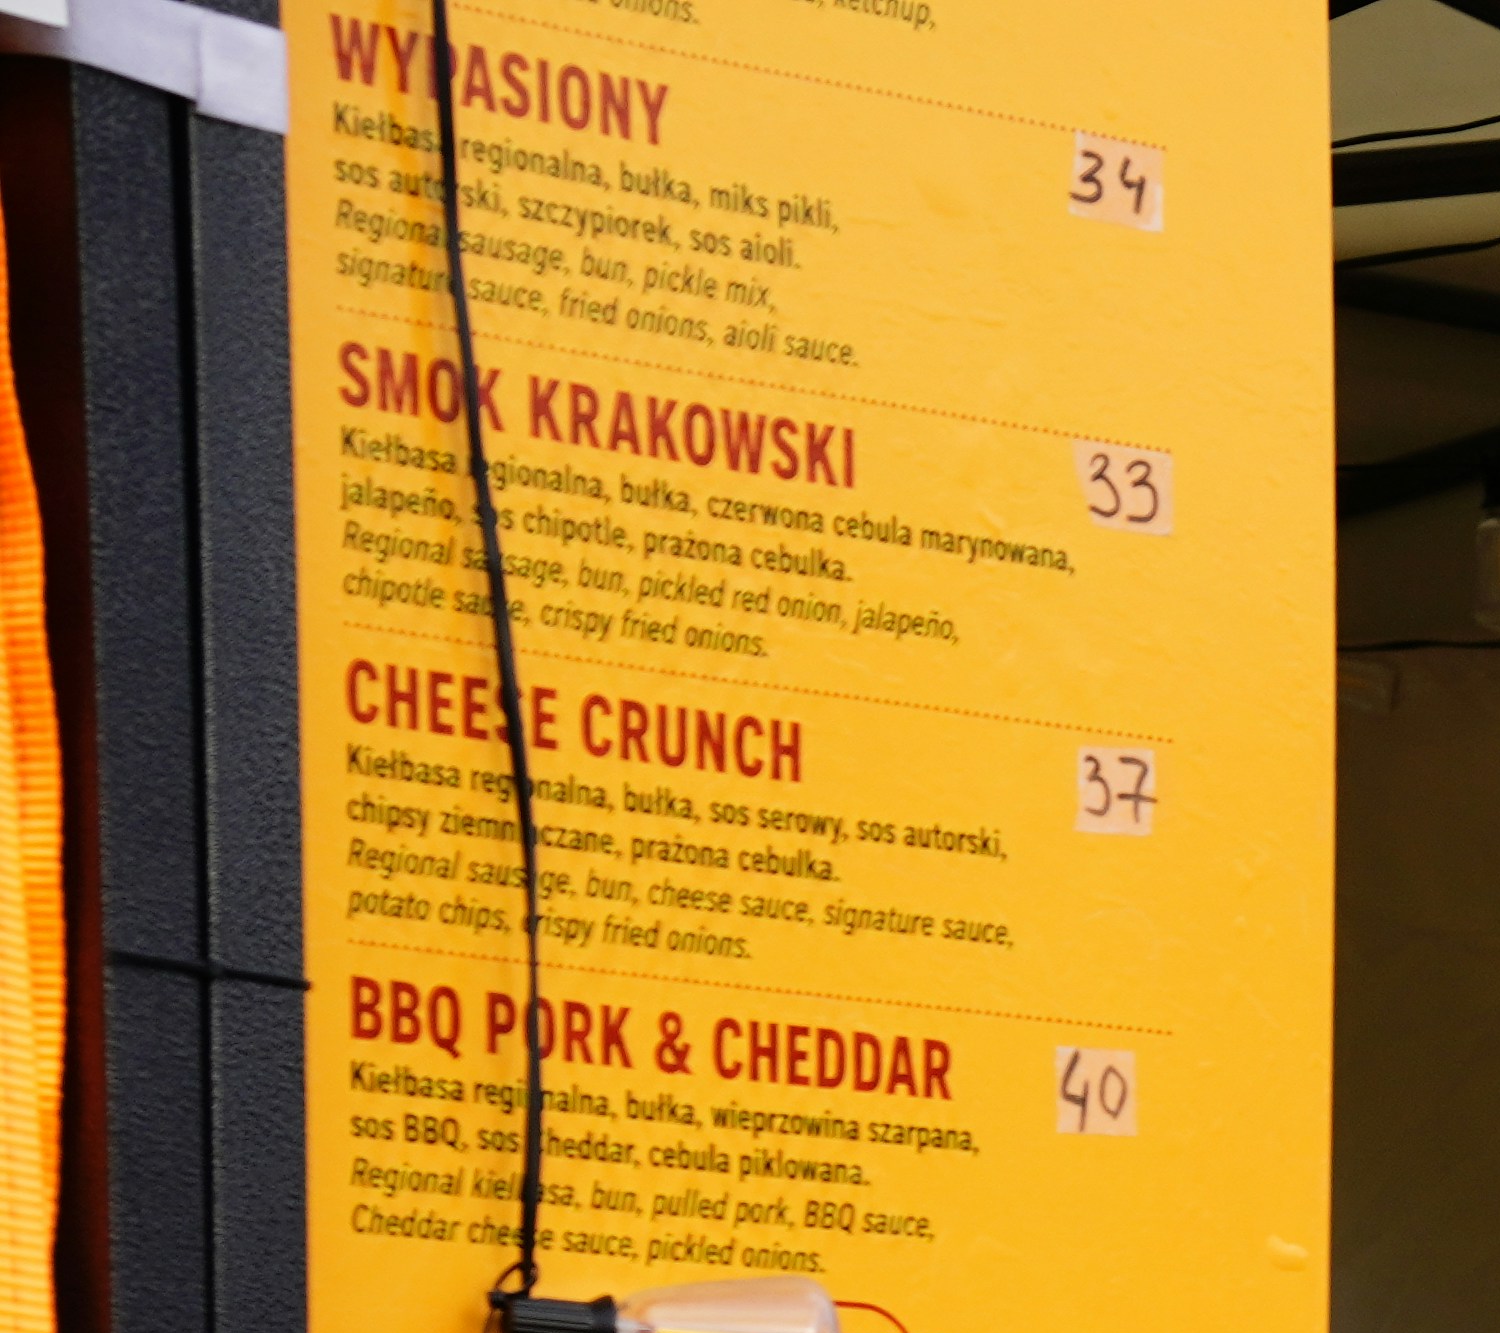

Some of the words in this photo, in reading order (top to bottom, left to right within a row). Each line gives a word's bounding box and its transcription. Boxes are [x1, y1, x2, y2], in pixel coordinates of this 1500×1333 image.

[460, 138, 611, 190] regionalna,
[620, 161, 699, 208] bułka,
[710, 183, 769, 218] miks
[778, 194, 838, 232] pikli,
[1069, 148, 1148, 215] 34
[519, 196, 680, 250] szczypiorek,
[689, 229, 730, 256] sos
[740, 232, 799, 268] aioli.
[338, 340, 505, 432] SMOK
[528, 374, 855, 489] KRAKOWSKI
[341, 425, 457, 474] Kiełbasa
[620, 473, 697, 516] bułka,
[707, 496, 824, 533] czerwona
[833, 511, 912, 546] cebula
[920, 528, 1074, 575] marynowana,
[1086, 451, 1159, 522] 33
[522, 504, 634, 552] chipotle,
[642, 530, 741, 567] prażona
[750, 543, 852, 582] cebulka.
[580, 692, 802, 783] CRUNCH
[346, 743, 460, 788] Kiełbasa
[623, 782, 701, 824] bułka,
[709, 801, 751, 827] sos
[757, 807, 849, 844] serowy,
[856, 819, 896, 844] sos
[903, 824, 1007, 860] autorski,
[1082, 752, 1157, 819] 37
[648, 878, 733, 913] cheese
[740, 895, 813, 923] sauce,
[823, 898, 934, 936] signature
[942, 918, 1013, 947] sauce,
[349, 974, 462, 1060] BBQ
[485, 990, 633, 1069] PORK
[653, 1010, 693, 1075] &
[711, 1016, 952, 1100] CHEDDAR
[350, 1060, 464, 1102] Kiełbasa
[626, 1090, 702, 1130] bułka,
[711, 1100, 860, 1141] wieprzowina
[867, 1121, 979, 1154] szarpana,
[1059, 1059, 1129, 1132] 40
[350, 1115, 394, 1141] sos
[403, 1112, 469, 1152] BBQ,
[476, 1128, 520, 1153] sos
[648, 1140, 730, 1174] cebula
[738, 1148, 870, 1186] piklowana.
